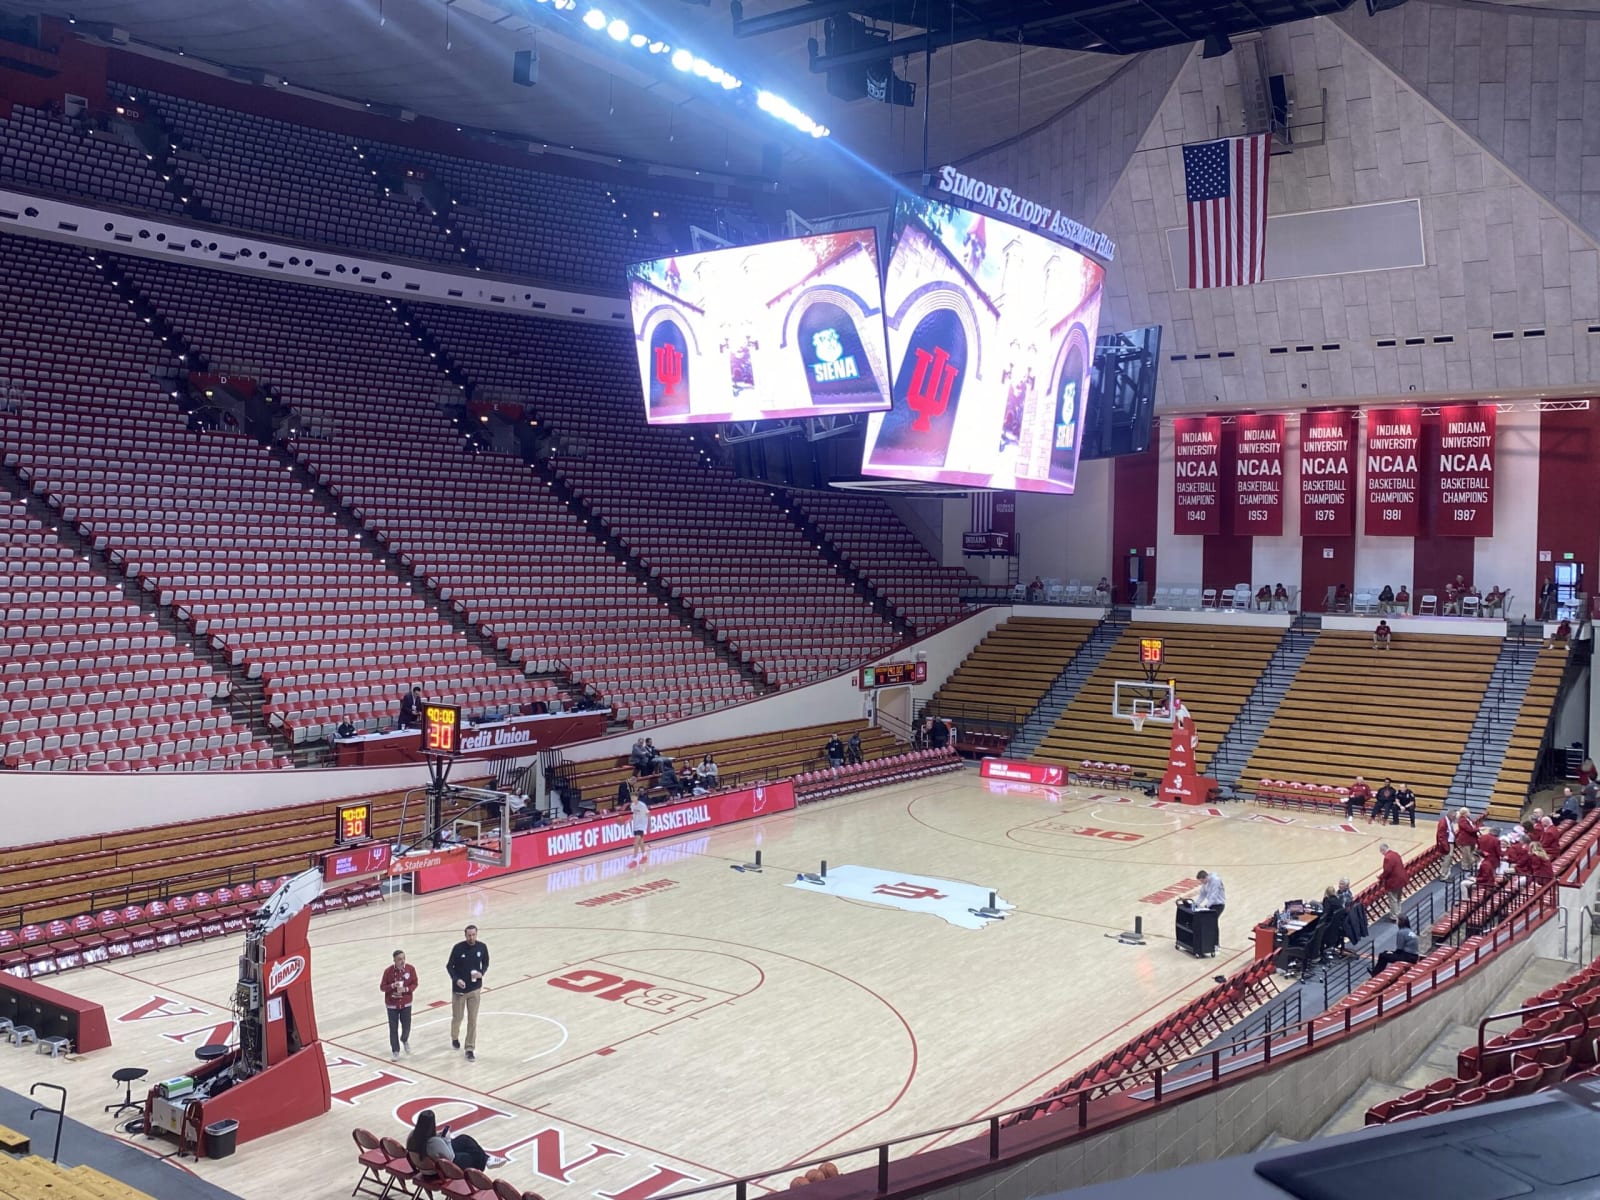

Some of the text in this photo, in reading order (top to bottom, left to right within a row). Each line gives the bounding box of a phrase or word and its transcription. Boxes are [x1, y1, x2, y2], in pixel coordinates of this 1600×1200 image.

[939, 165, 1116, 259] SIMON SKJODT ASSEMBLY HALL
[814, 355, 858, 383] SIENA
[1309, 427, 1343, 439] INDIANA
[1376, 424, 1412, 436] INDIANA
[1448, 421, 1486, 434] INDIANA
[1182, 432, 1213, 443] INDIANA
[1244, 429, 1276, 441] INDIANA
[1304, 440, 1348, 452] UNIVERSITY
[1370, 438, 1417, 450] UNIVERSITY
[1442, 435, 1491, 448] UNIVERSITY
[1178, 444, 1217, 456] UNIVERSITY
[1239, 443, 1280, 454] UNIVERSITY
[1176, 460, 1218, 477] NCAA
[1237, 459, 1282, 476] NCAA
[1302, 457, 1348, 475] NCAA
[1368, 455, 1418, 473] NCAA
[1440, 453, 1492, 472] NCAA
[1177, 482, 1216, 493] BASKETBALL
[1238, 481, 1280, 492] BASKETBALL
[1303, 480, 1346, 491] BASKETBALL
[1369, 478, 1416, 489] BASKETBALL
[1441, 477, 1490, 489] BASKETBALL
[1178, 495, 1215, 505] CHAMPIONS
[1239, 494, 1278, 505] CHAMPIONS
[1304, 493, 1345, 504] CHAMPIONS
[1370, 492, 1414, 503] CHAMPIONS
[1443, 491, 1488, 503] CHAMPIONS
[1187, 510, 1206, 521] 1940
[1248, 510, 1268, 521] 1953
[1315, 509, 1335, 521] 1976
[1383, 509, 1401, 520] 1981
[1454, 509, 1476, 521] 1987
[1144, 647, 1160, 661] 30
[430, 723, 451, 749] 30
[460, 726, 531, 750] redit Union
[346, 820, 362, 837] 30
[548, 804, 711, 857] HOME OF INDIA BASKETBALL
[270, 959, 301, 991] LIBMAN
